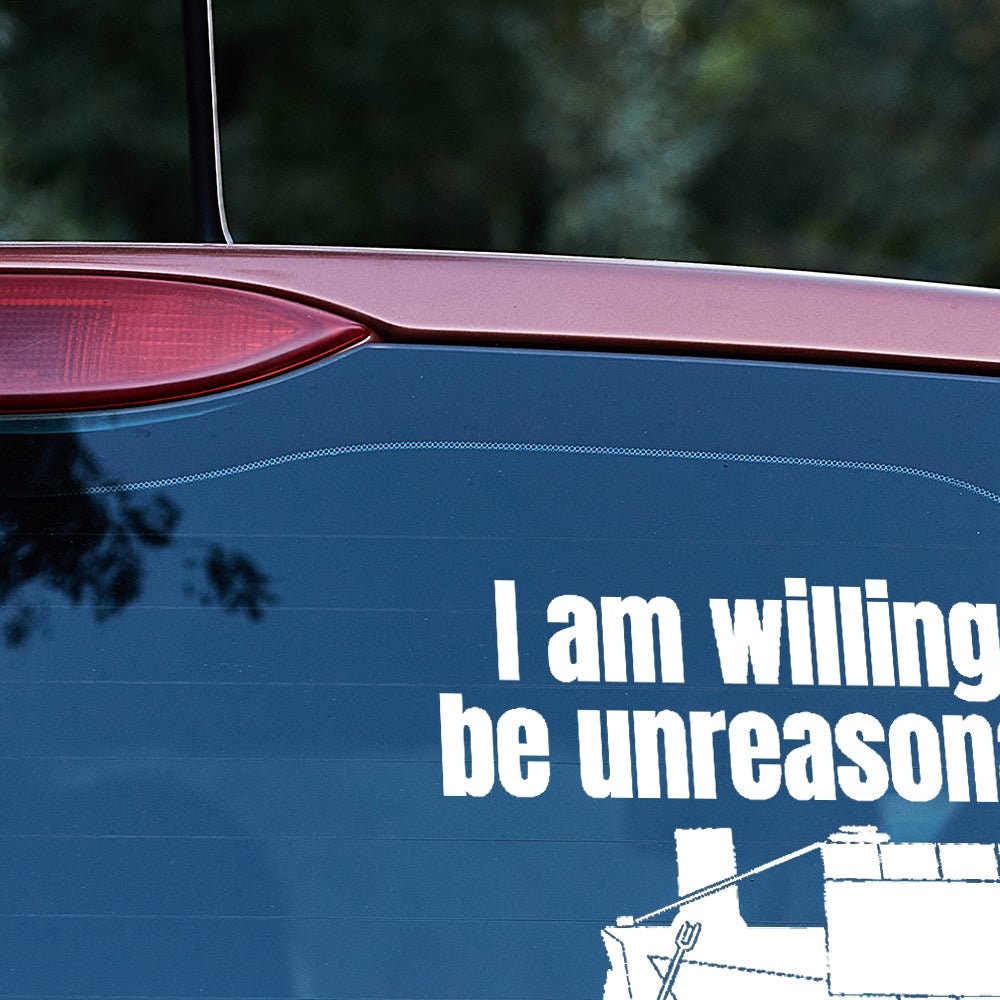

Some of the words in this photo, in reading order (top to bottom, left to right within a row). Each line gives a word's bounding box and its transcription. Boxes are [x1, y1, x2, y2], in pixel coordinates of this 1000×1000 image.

[494, 579, 520, 682] I
[547, 594, 685, 685] am
[439, 693, 551, 798] be
